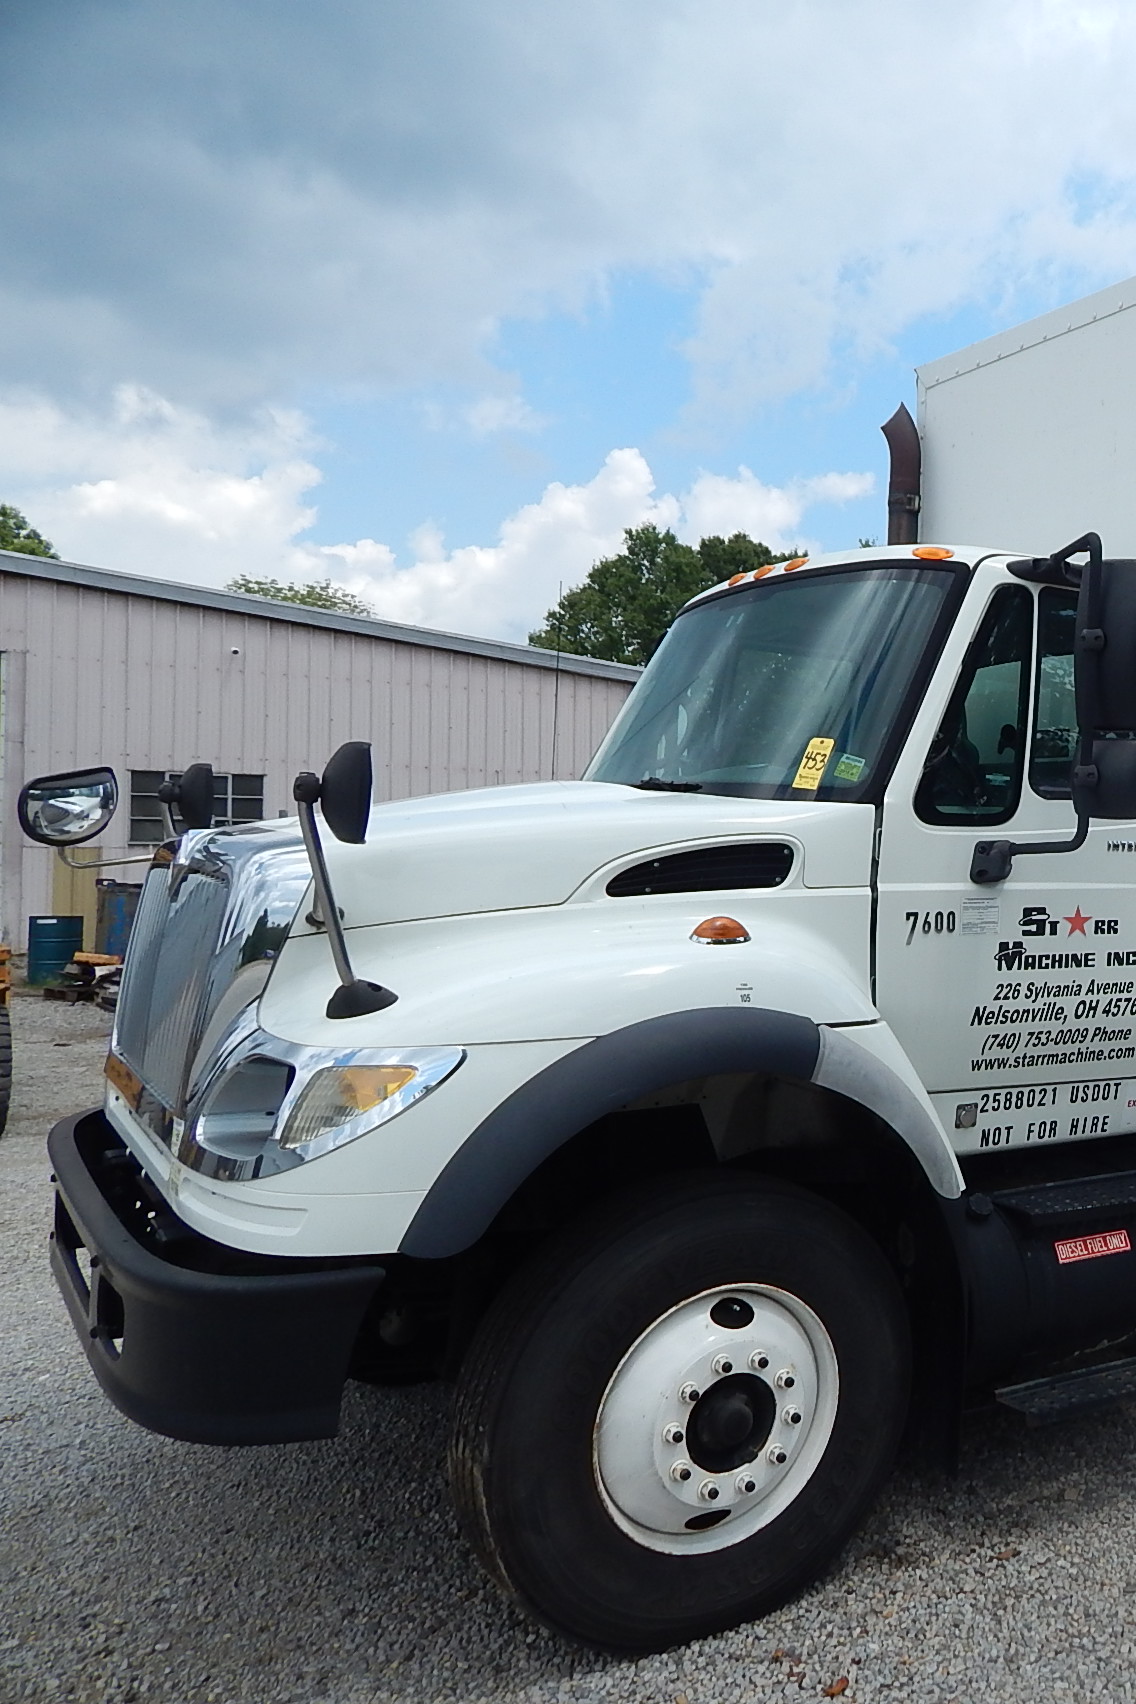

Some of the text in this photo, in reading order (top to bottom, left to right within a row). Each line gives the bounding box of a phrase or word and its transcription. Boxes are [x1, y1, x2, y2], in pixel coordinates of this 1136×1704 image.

[803, 751, 827, 771] 453
[905, 910, 956, 946] 7600
[994, 941, 1096, 971] MACHINE
[992, 979, 1135, 1003] 226 Sylvania Avenue
[970, 1002, 1068, 1027] Nelsonville,
[1073, 1000, 1101, 1020] OH
[980, 1025, 1133, 1055] (740) 753-0009 Phone
[970, 1045, 1136, 1072] www.starrmachine.com
[979, 1081, 1122, 1114] 2588021 USDOT
[979, 1115, 1111, 1149] NOT FOR HIRE
[1058, 1233, 1126, 1259] DIESEL FUEL ONLY
